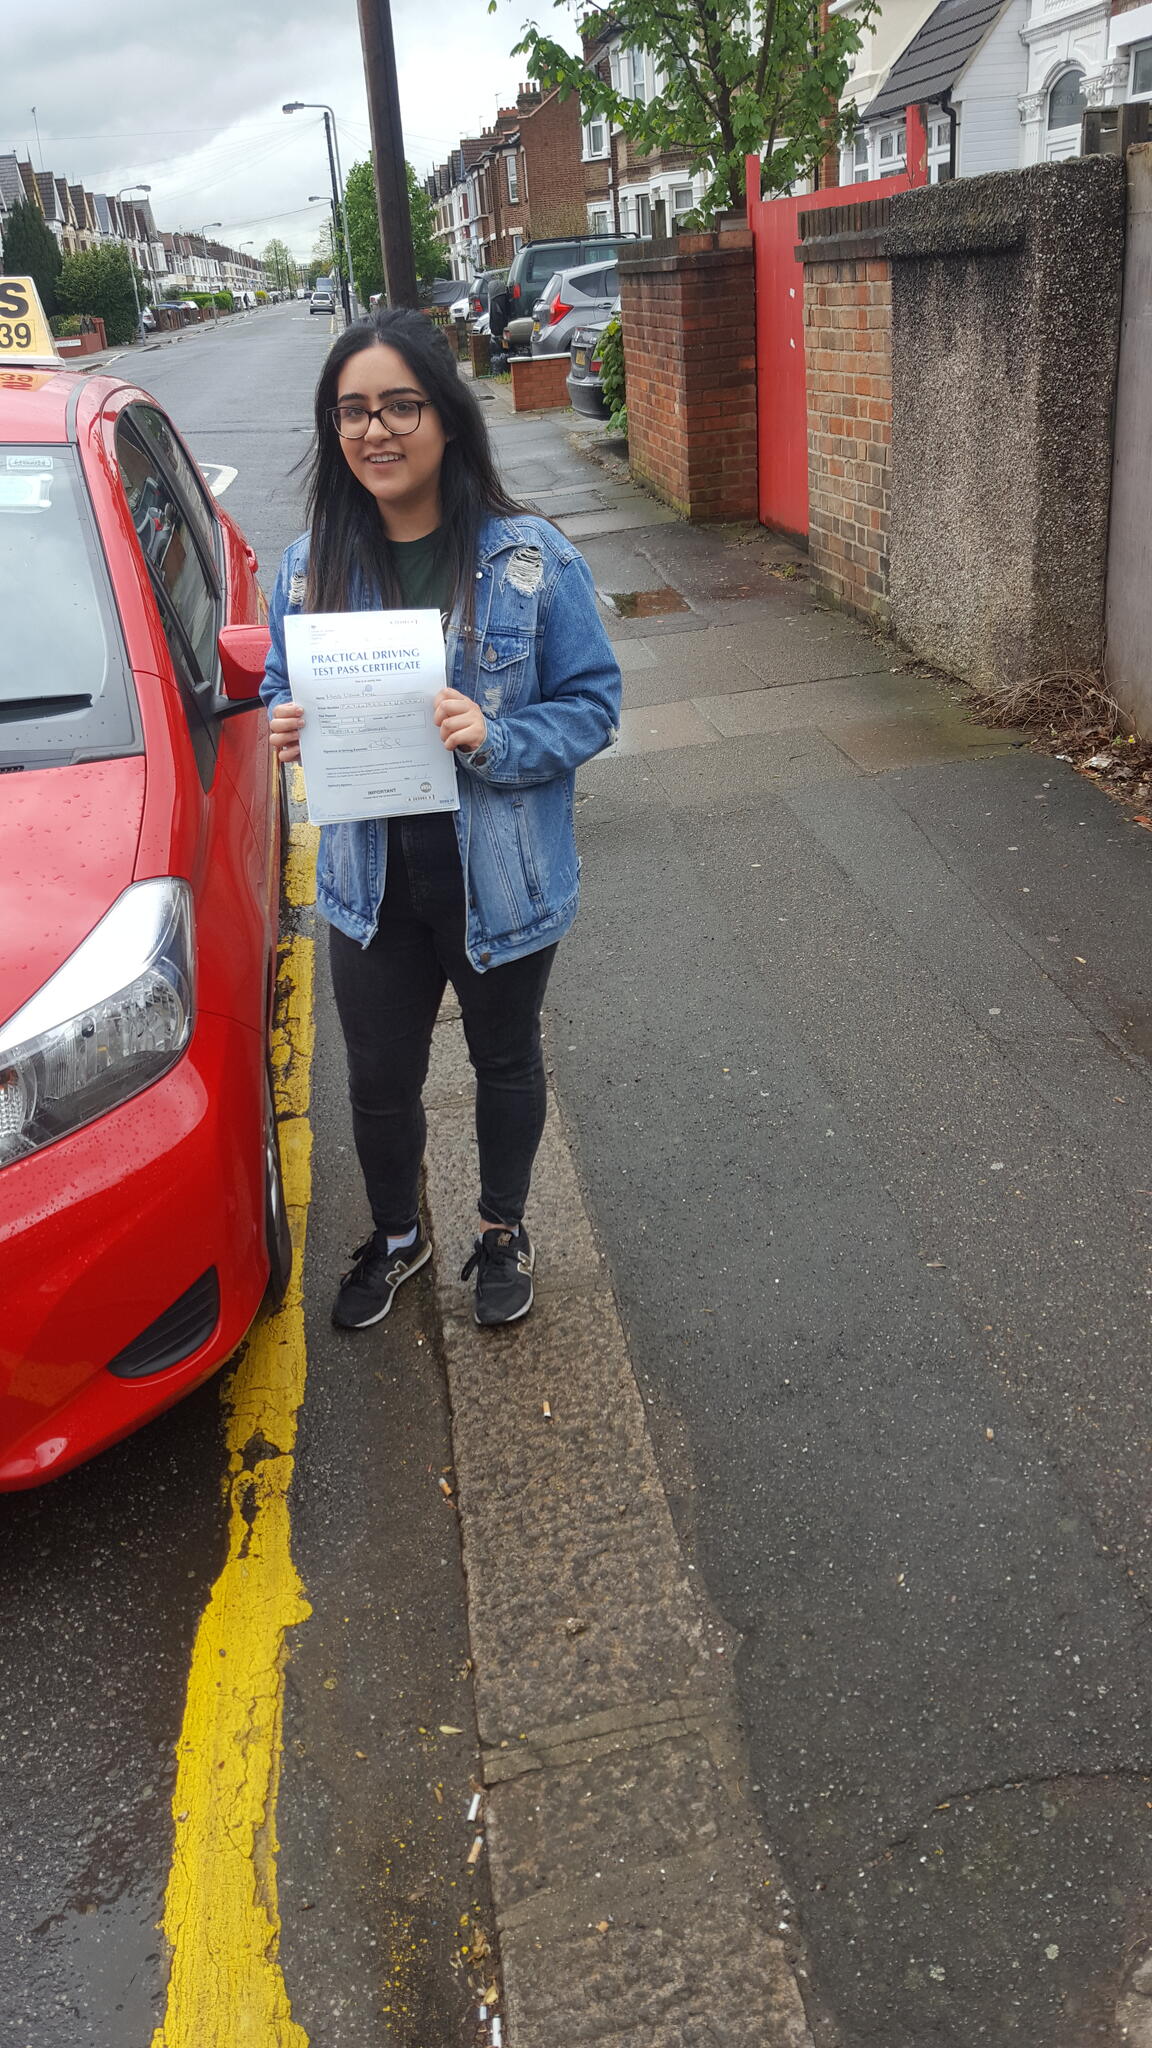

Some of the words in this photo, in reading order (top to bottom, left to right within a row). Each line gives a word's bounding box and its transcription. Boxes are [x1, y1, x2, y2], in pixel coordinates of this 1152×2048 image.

[311, 651, 369, 664] PRACTICAL
[372, 648, 420, 660] DRIVING
[312, 667, 334, 677] TEST
[337, 665, 360, 675] PASS
[362, 661, 421, 673] CERTIFICATE
[367, 788, 397, 796] IMPORTANT
